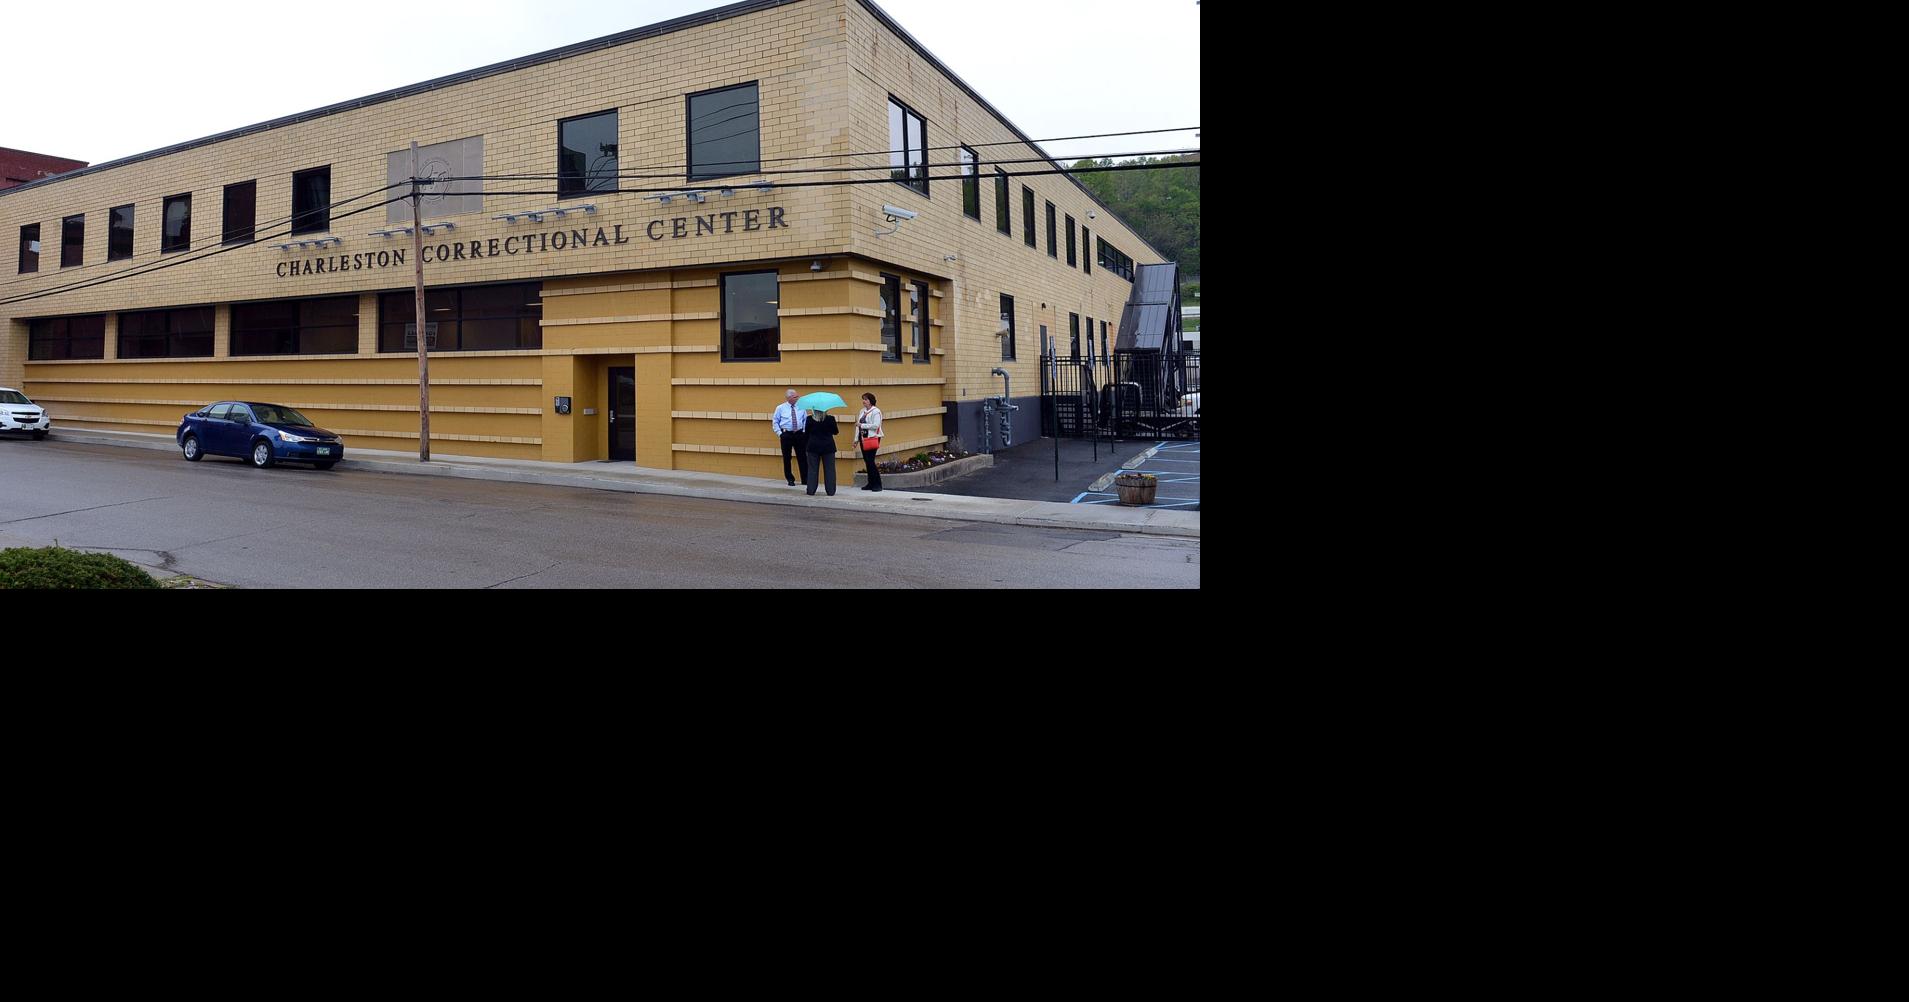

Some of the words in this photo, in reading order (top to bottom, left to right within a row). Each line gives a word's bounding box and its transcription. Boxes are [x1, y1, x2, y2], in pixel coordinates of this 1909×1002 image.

[276, 248, 406, 278] CHARLESTON
[421, 224, 629, 263] CORRECTIONAL
[646, 206, 789, 241] CENTER
